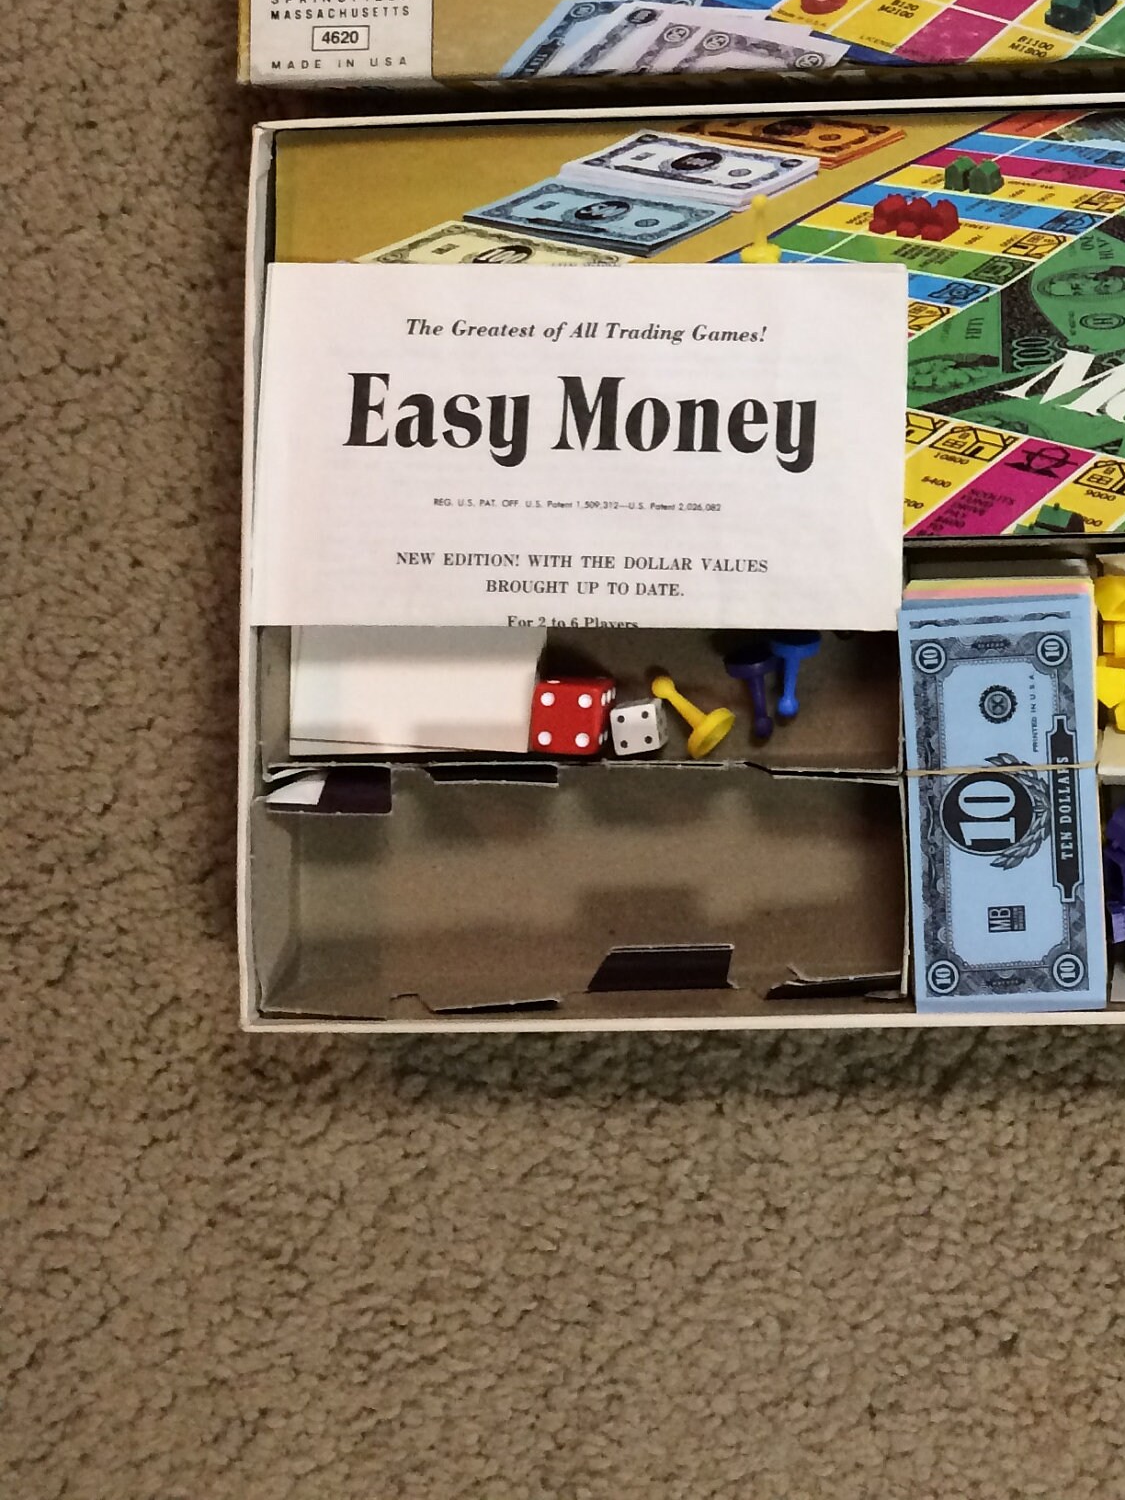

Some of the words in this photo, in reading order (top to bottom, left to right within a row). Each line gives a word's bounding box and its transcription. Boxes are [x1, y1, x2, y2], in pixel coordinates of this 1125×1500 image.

[271, 6, 409, 20] MASSACHUSETTS
[322, 30, 359, 44] 4620
[271, 59, 321, 70] MADE
[338, 59, 354, 68] IN
[406, 318, 444, 337] The
[451, 319, 536, 338] Greatest
[543, 321, 568, 342] of
[569, 322, 599, 339] All
[605, 322, 685, 345] Trading
[692, 324, 768, 342] Games!
[342, 371, 531, 467] Easy
[551, 376, 816, 473] Money
[932, 451, 970, 465] 10800
[921, 475, 952, 488] 5400
[1084, 489, 1116, 501] 9000
[547, 500, 573, 509] Patent
[396, 552, 435, 566] NEW
[443, 552, 520, 567] EDITION!
[528, 554, 573, 568] WITH
[580, 555, 616, 569] THE
[624, 556, 692, 571] DOLLAR
[701, 558, 769, 573] VALUES
[486, 580, 569, 594] BROUGHT
[577, 581, 600, 594] UP
[607, 582, 629, 595] TO
[635, 583, 685, 597] DATE.
[507, 615, 534, 627] For
[538, 616, 546, 627] 2
[551, 617, 567, 627] to
[570, 617, 579, 628] 6
[1044, 643, 1060, 658] 10
[922, 652, 938, 666] 10
[1031, 703, 1037, 715] IN
[1031, 718, 1039, 752] PRINTED
[957, 780, 1017, 847] 10
[1061, 834, 1074, 860] TEN
[989, 908, 1012, 931] MB
[935, 967, 951, 986] 10
[1060, 961, 1076, 980] 10
